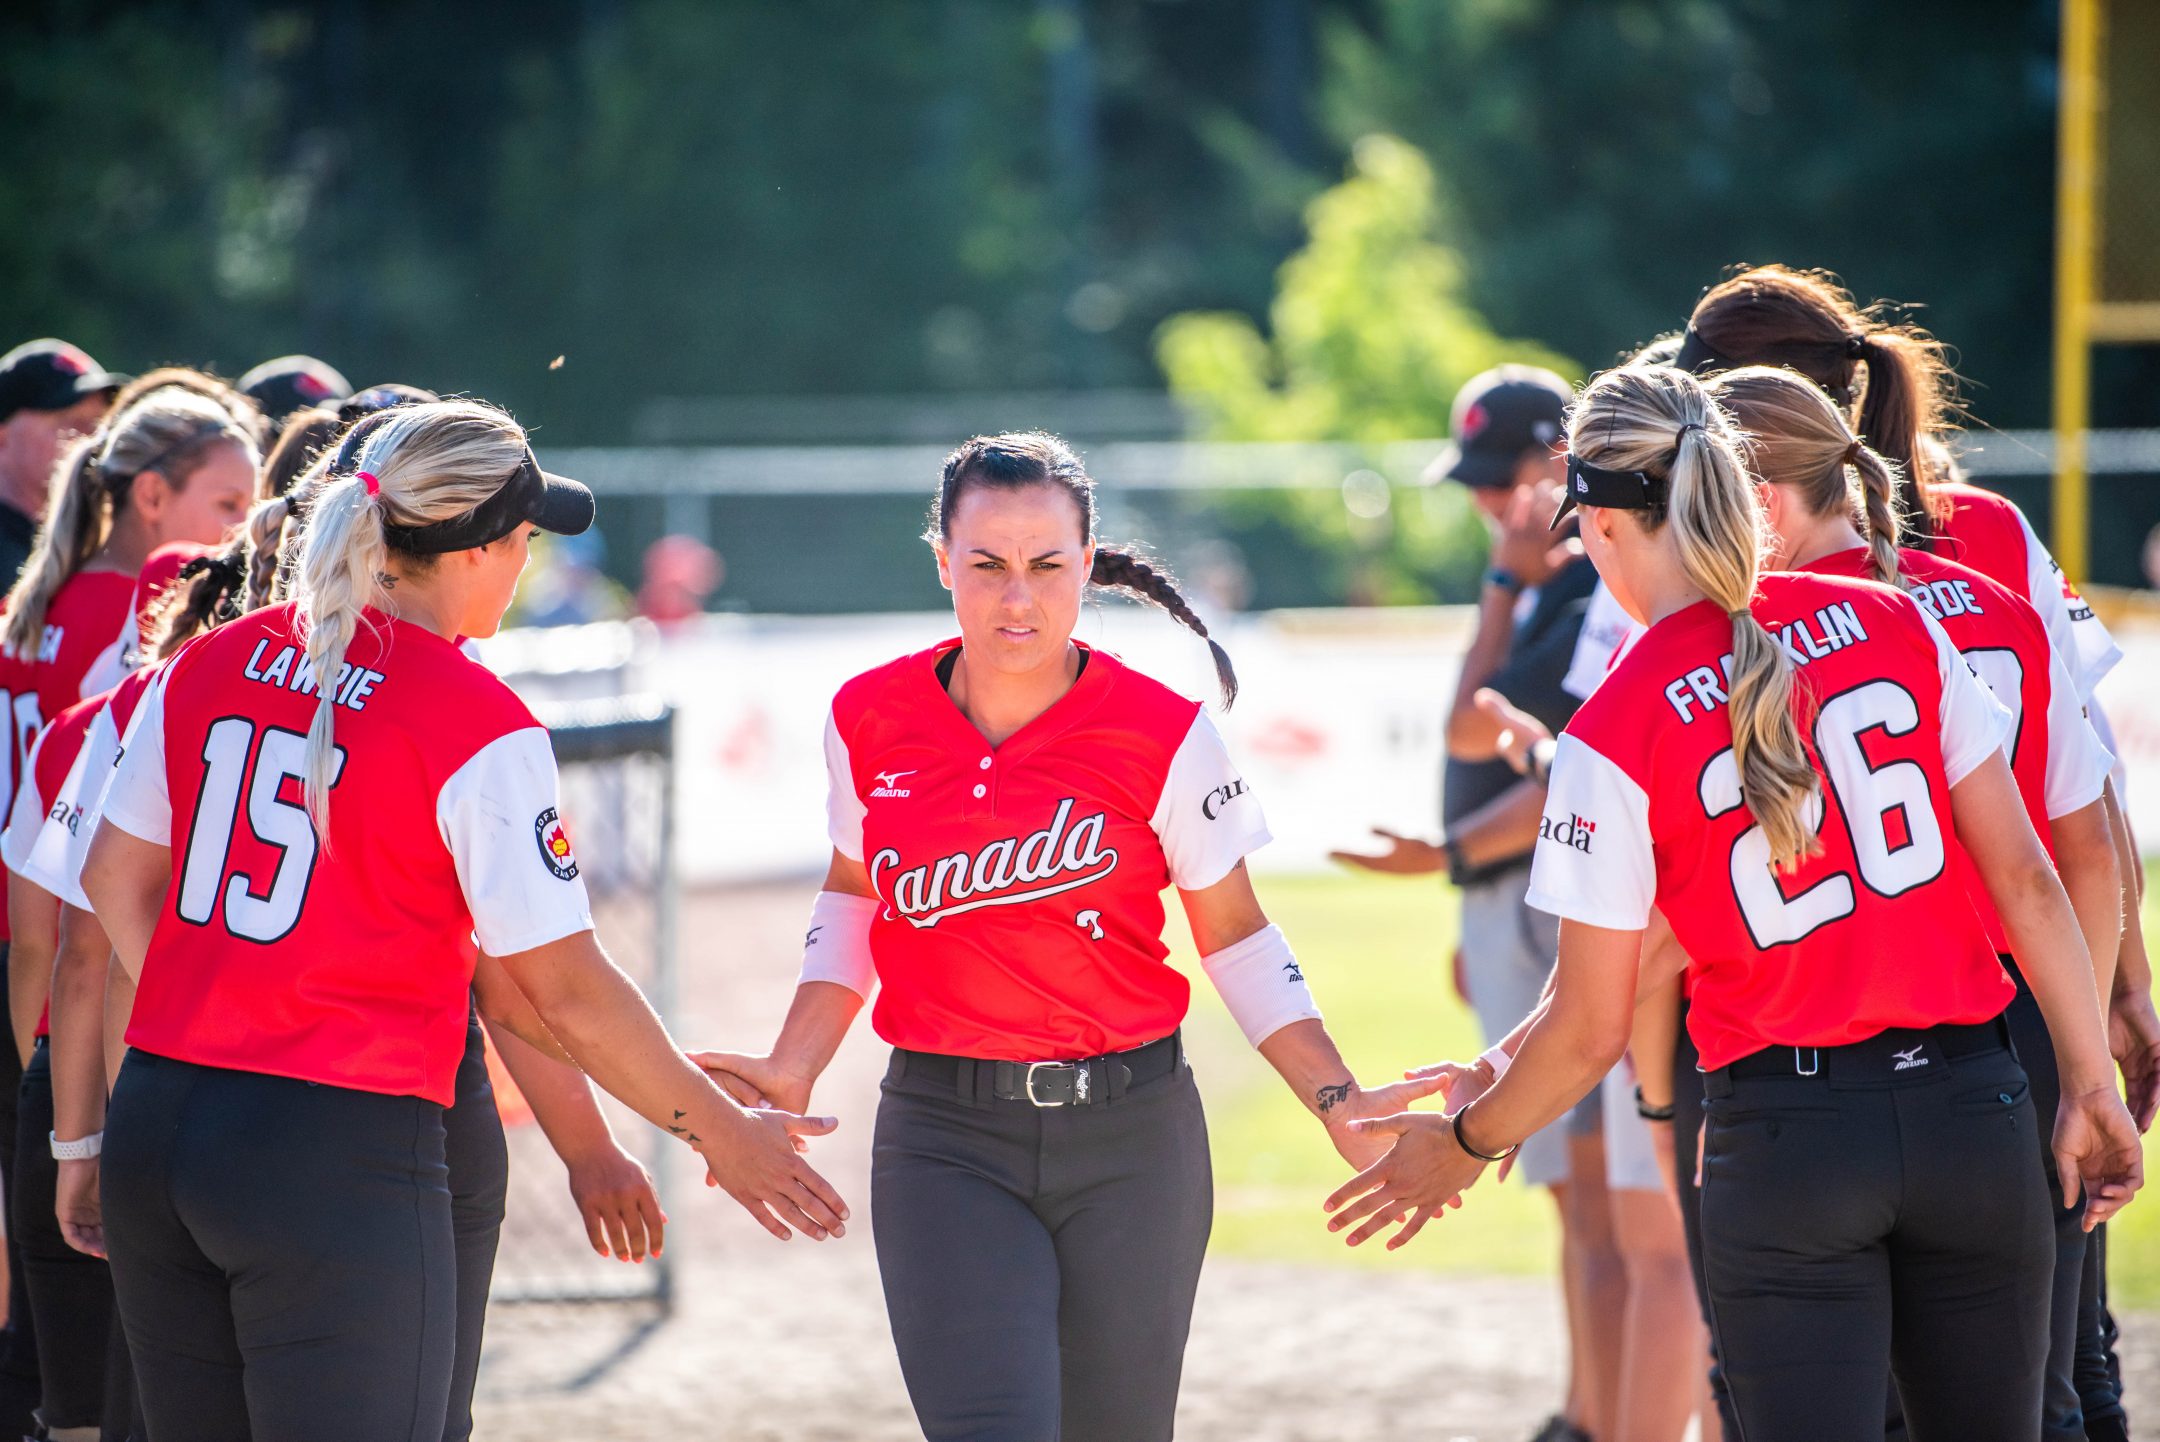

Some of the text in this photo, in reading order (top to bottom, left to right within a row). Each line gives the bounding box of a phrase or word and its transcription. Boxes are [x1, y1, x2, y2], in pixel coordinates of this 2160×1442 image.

[1663, 600, 1869, 725] FRKLIN
[176, 714, 348, 945] 15
[870, 796, 1119, 927] Canada
[1697, 677, 1945, 952] 26
